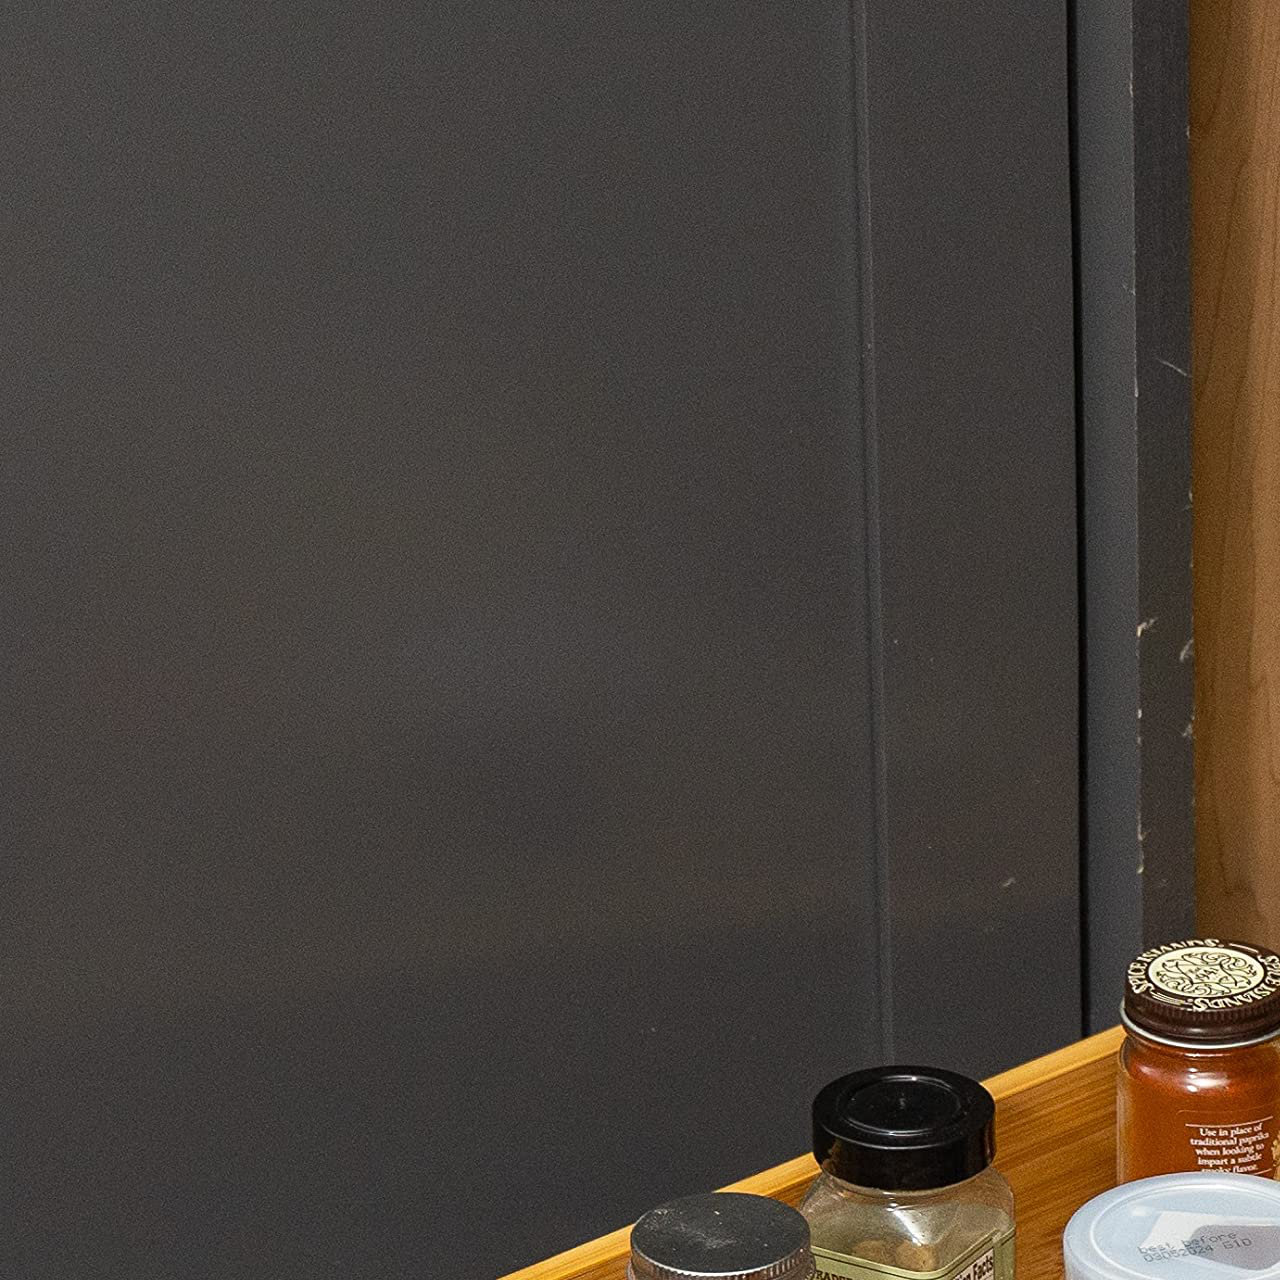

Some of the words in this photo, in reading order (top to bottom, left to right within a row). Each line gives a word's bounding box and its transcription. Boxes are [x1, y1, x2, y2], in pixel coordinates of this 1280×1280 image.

[1127, 961, 1148, 994] SPICE
[1200, 1128, 1217, 1136] Use
[1219, 1128, 1228, 1136] in
[1230, 1126, 1252, 1138] place
[1253, 1122, 1263, 1132] of
[1190, 1137, 1237, 1146] traditional
[1238, 1132, 1270, 1146] paprika
[1195, 1147, 1220, 1155] when
[1222, 1145, 1254, 1155] looking
[1198, 1157, 1228, 1167] impart
[1238, 1152, 1262, 1163] subtle
[1181, 1232, 1237, 1248] before
